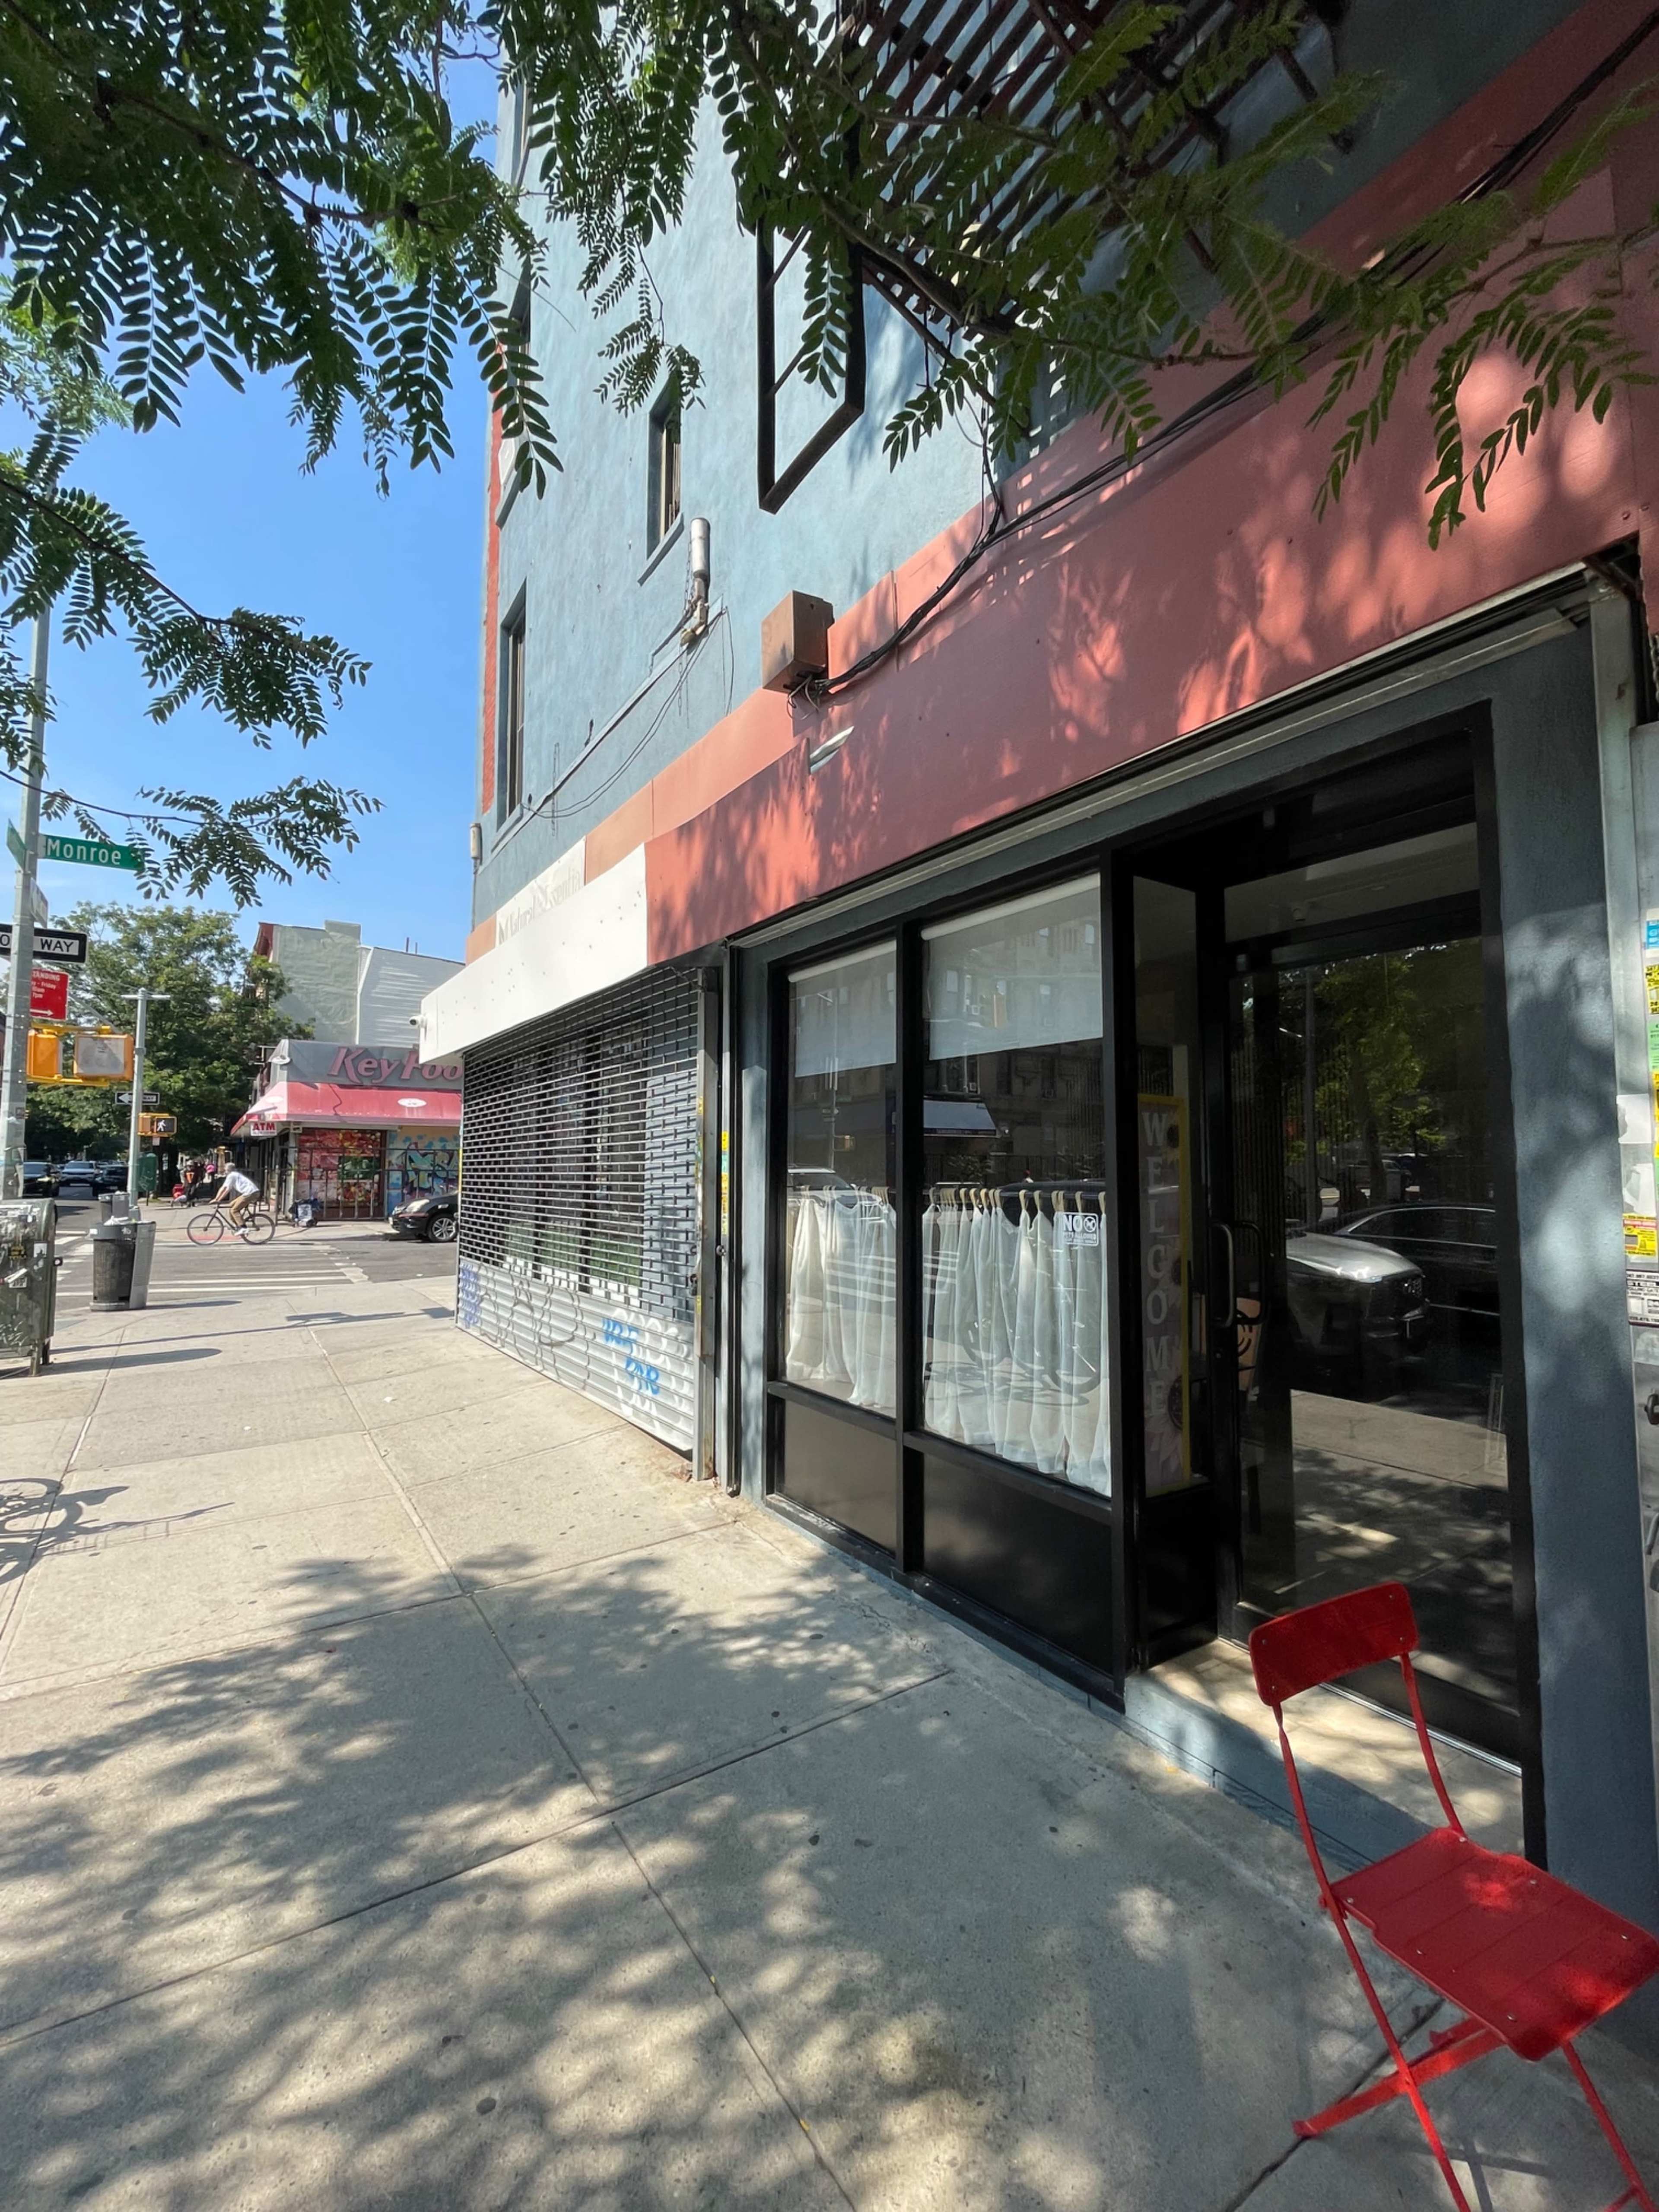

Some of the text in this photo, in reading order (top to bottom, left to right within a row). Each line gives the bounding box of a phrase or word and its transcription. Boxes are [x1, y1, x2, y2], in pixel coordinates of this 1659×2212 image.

[47, 839, 121, 864] Monroe
[40, 938, 74, 952] WAY
[32, 971, 60, 981] TANDING
[327, 1046, 463, 1084] Key Foo
[252, 1122, 275, 1130] ATM
[1063, 1214, 1082, 1232] NO
[1142, 1112, 1169, 1416] WELCOME
